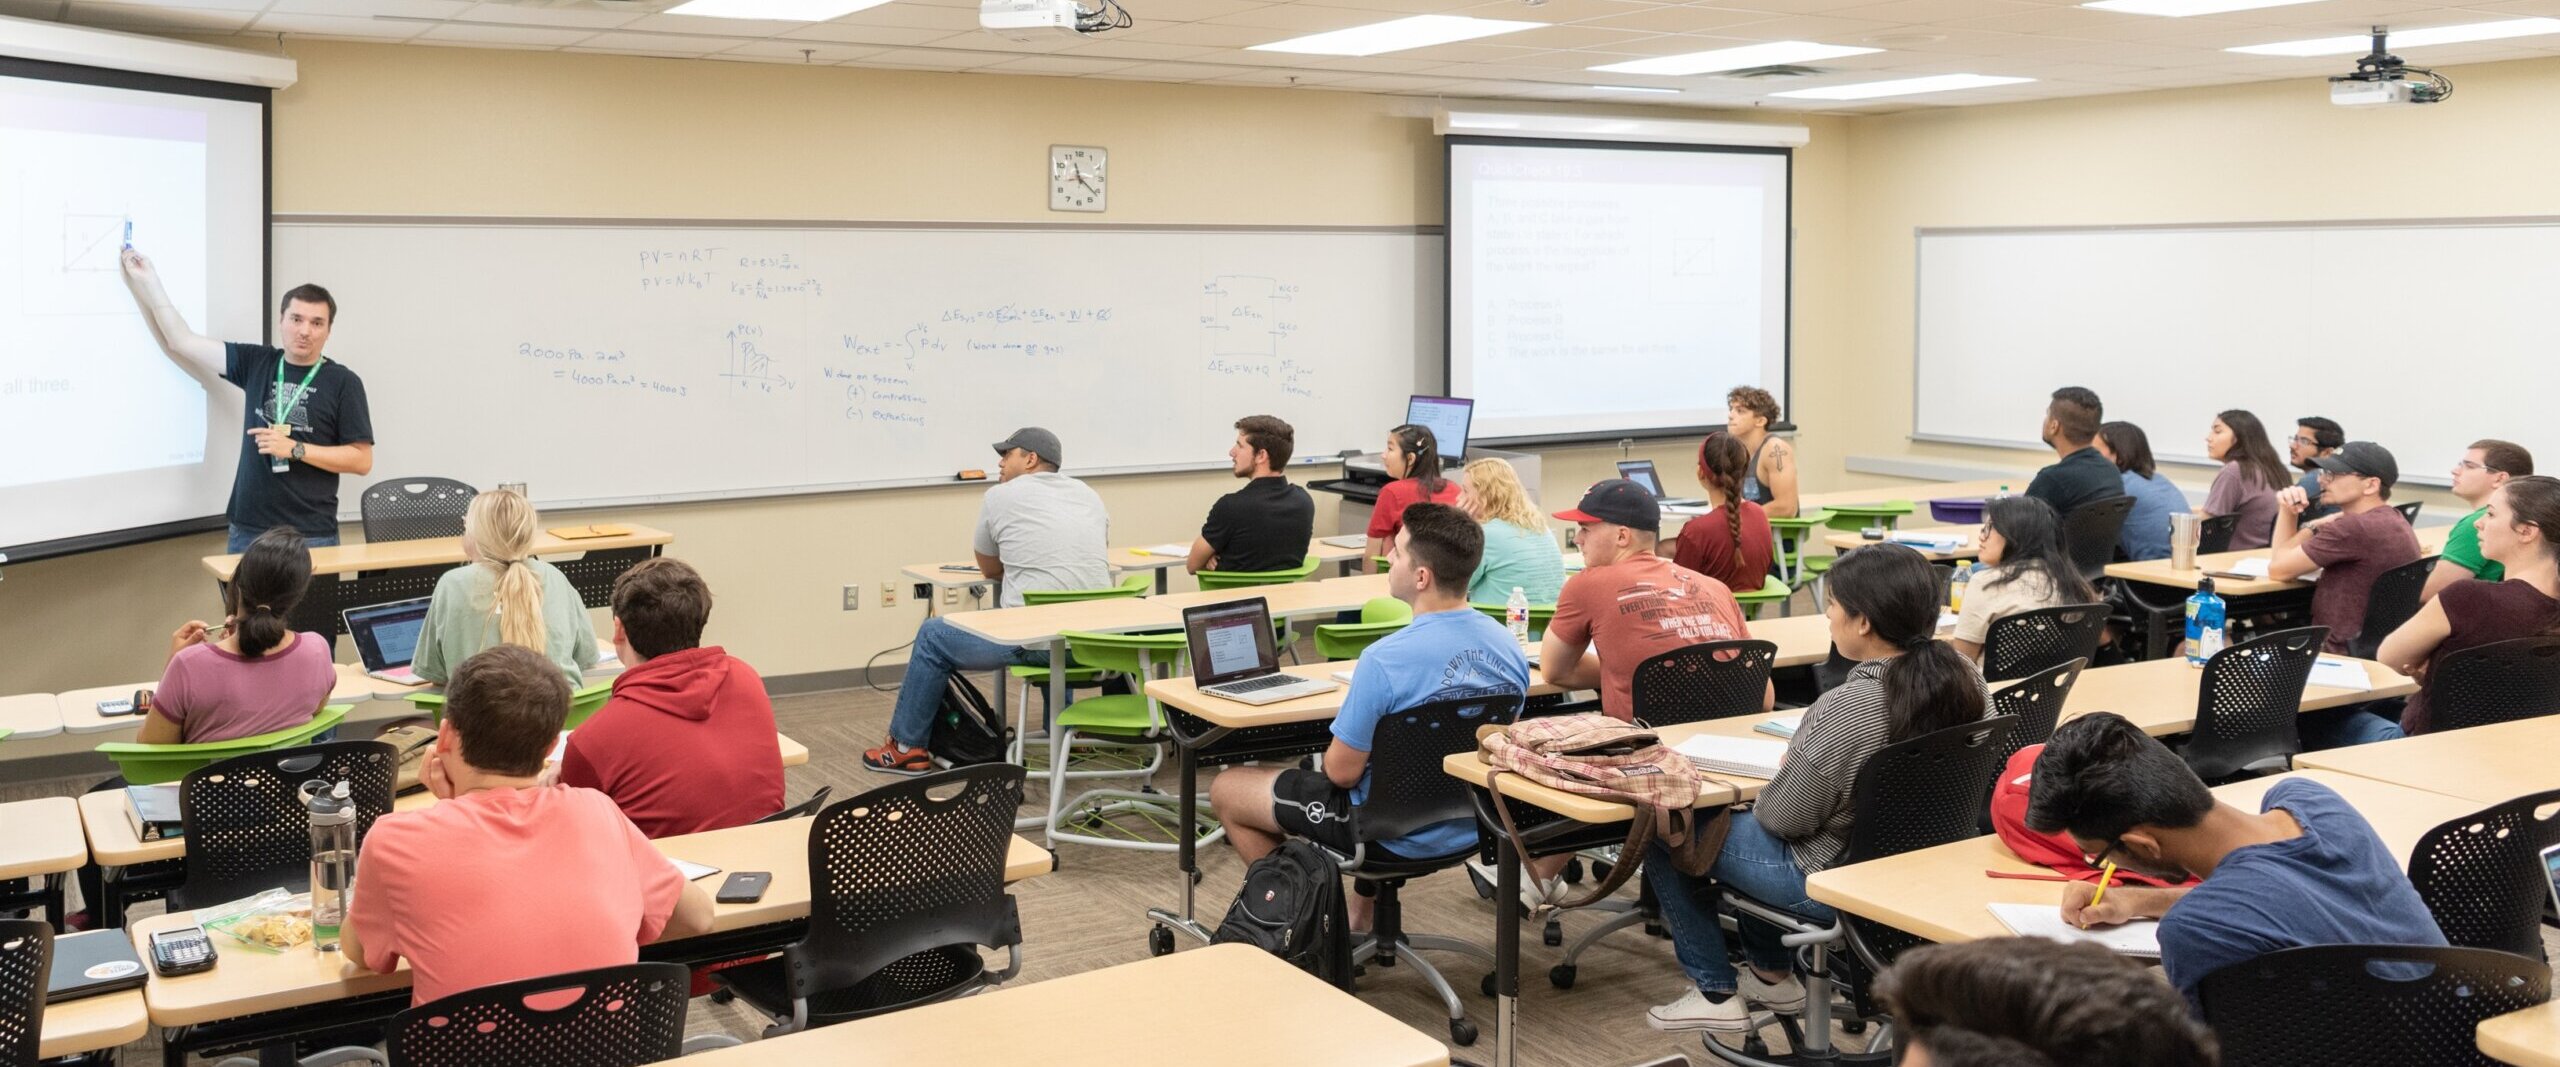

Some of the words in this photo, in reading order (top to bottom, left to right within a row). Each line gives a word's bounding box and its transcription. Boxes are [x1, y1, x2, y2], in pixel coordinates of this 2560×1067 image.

[3, 377, 23, 394] all
[1677, 626, 1700, 639] CALLS
[1441, 654, 1465, 687] DOWN
[1464, 649, 1484, 662] THE
